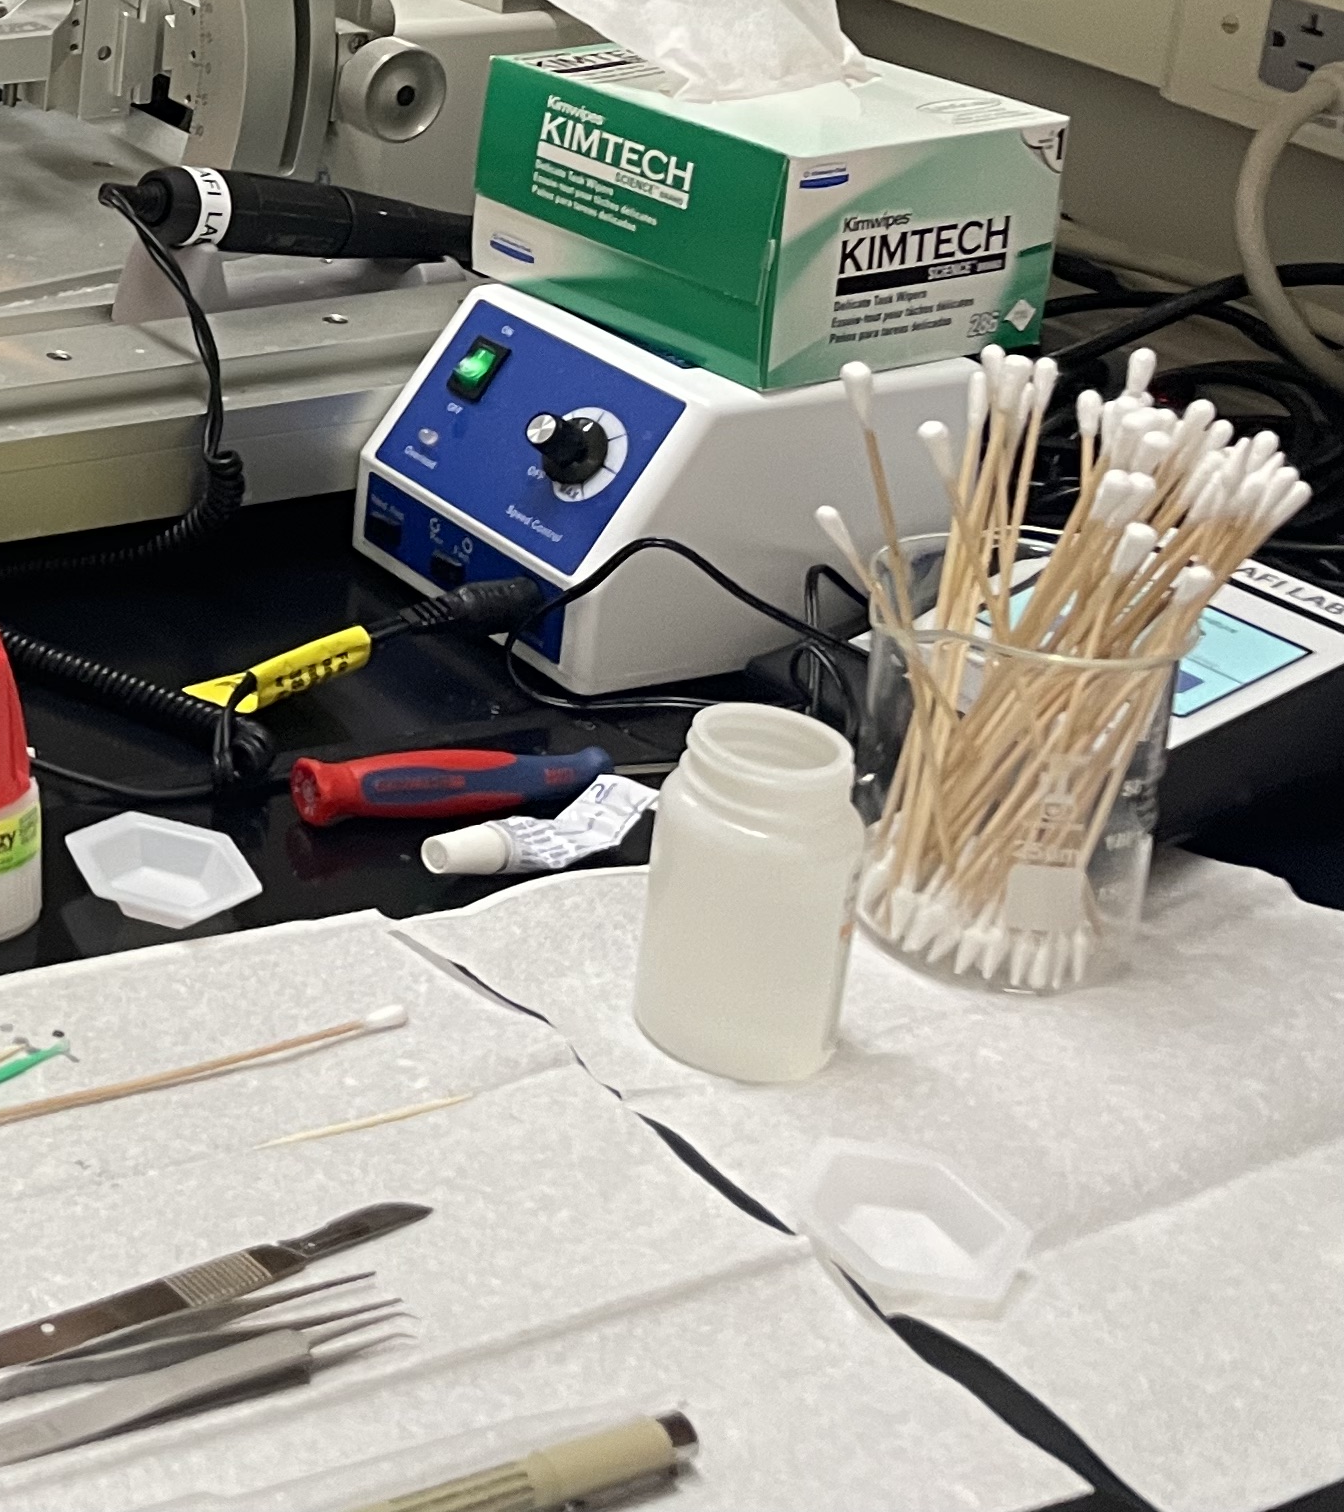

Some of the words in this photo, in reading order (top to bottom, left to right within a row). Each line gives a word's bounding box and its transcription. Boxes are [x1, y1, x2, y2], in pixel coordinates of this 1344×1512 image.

[546, 94, 605, 126] Kimwipes
[540, 111, 694, 192] KIMTECH
[615, 171, 654, 196] SCIENCE
[842, 211, 912, 234] Kimwipes
[839, 215, 1012, 275] KIMTECH
[928, 263, 971, 281] SCIENCE
[505, 503, 533, 526] Speed
[531, 519, 564, 544] Control
